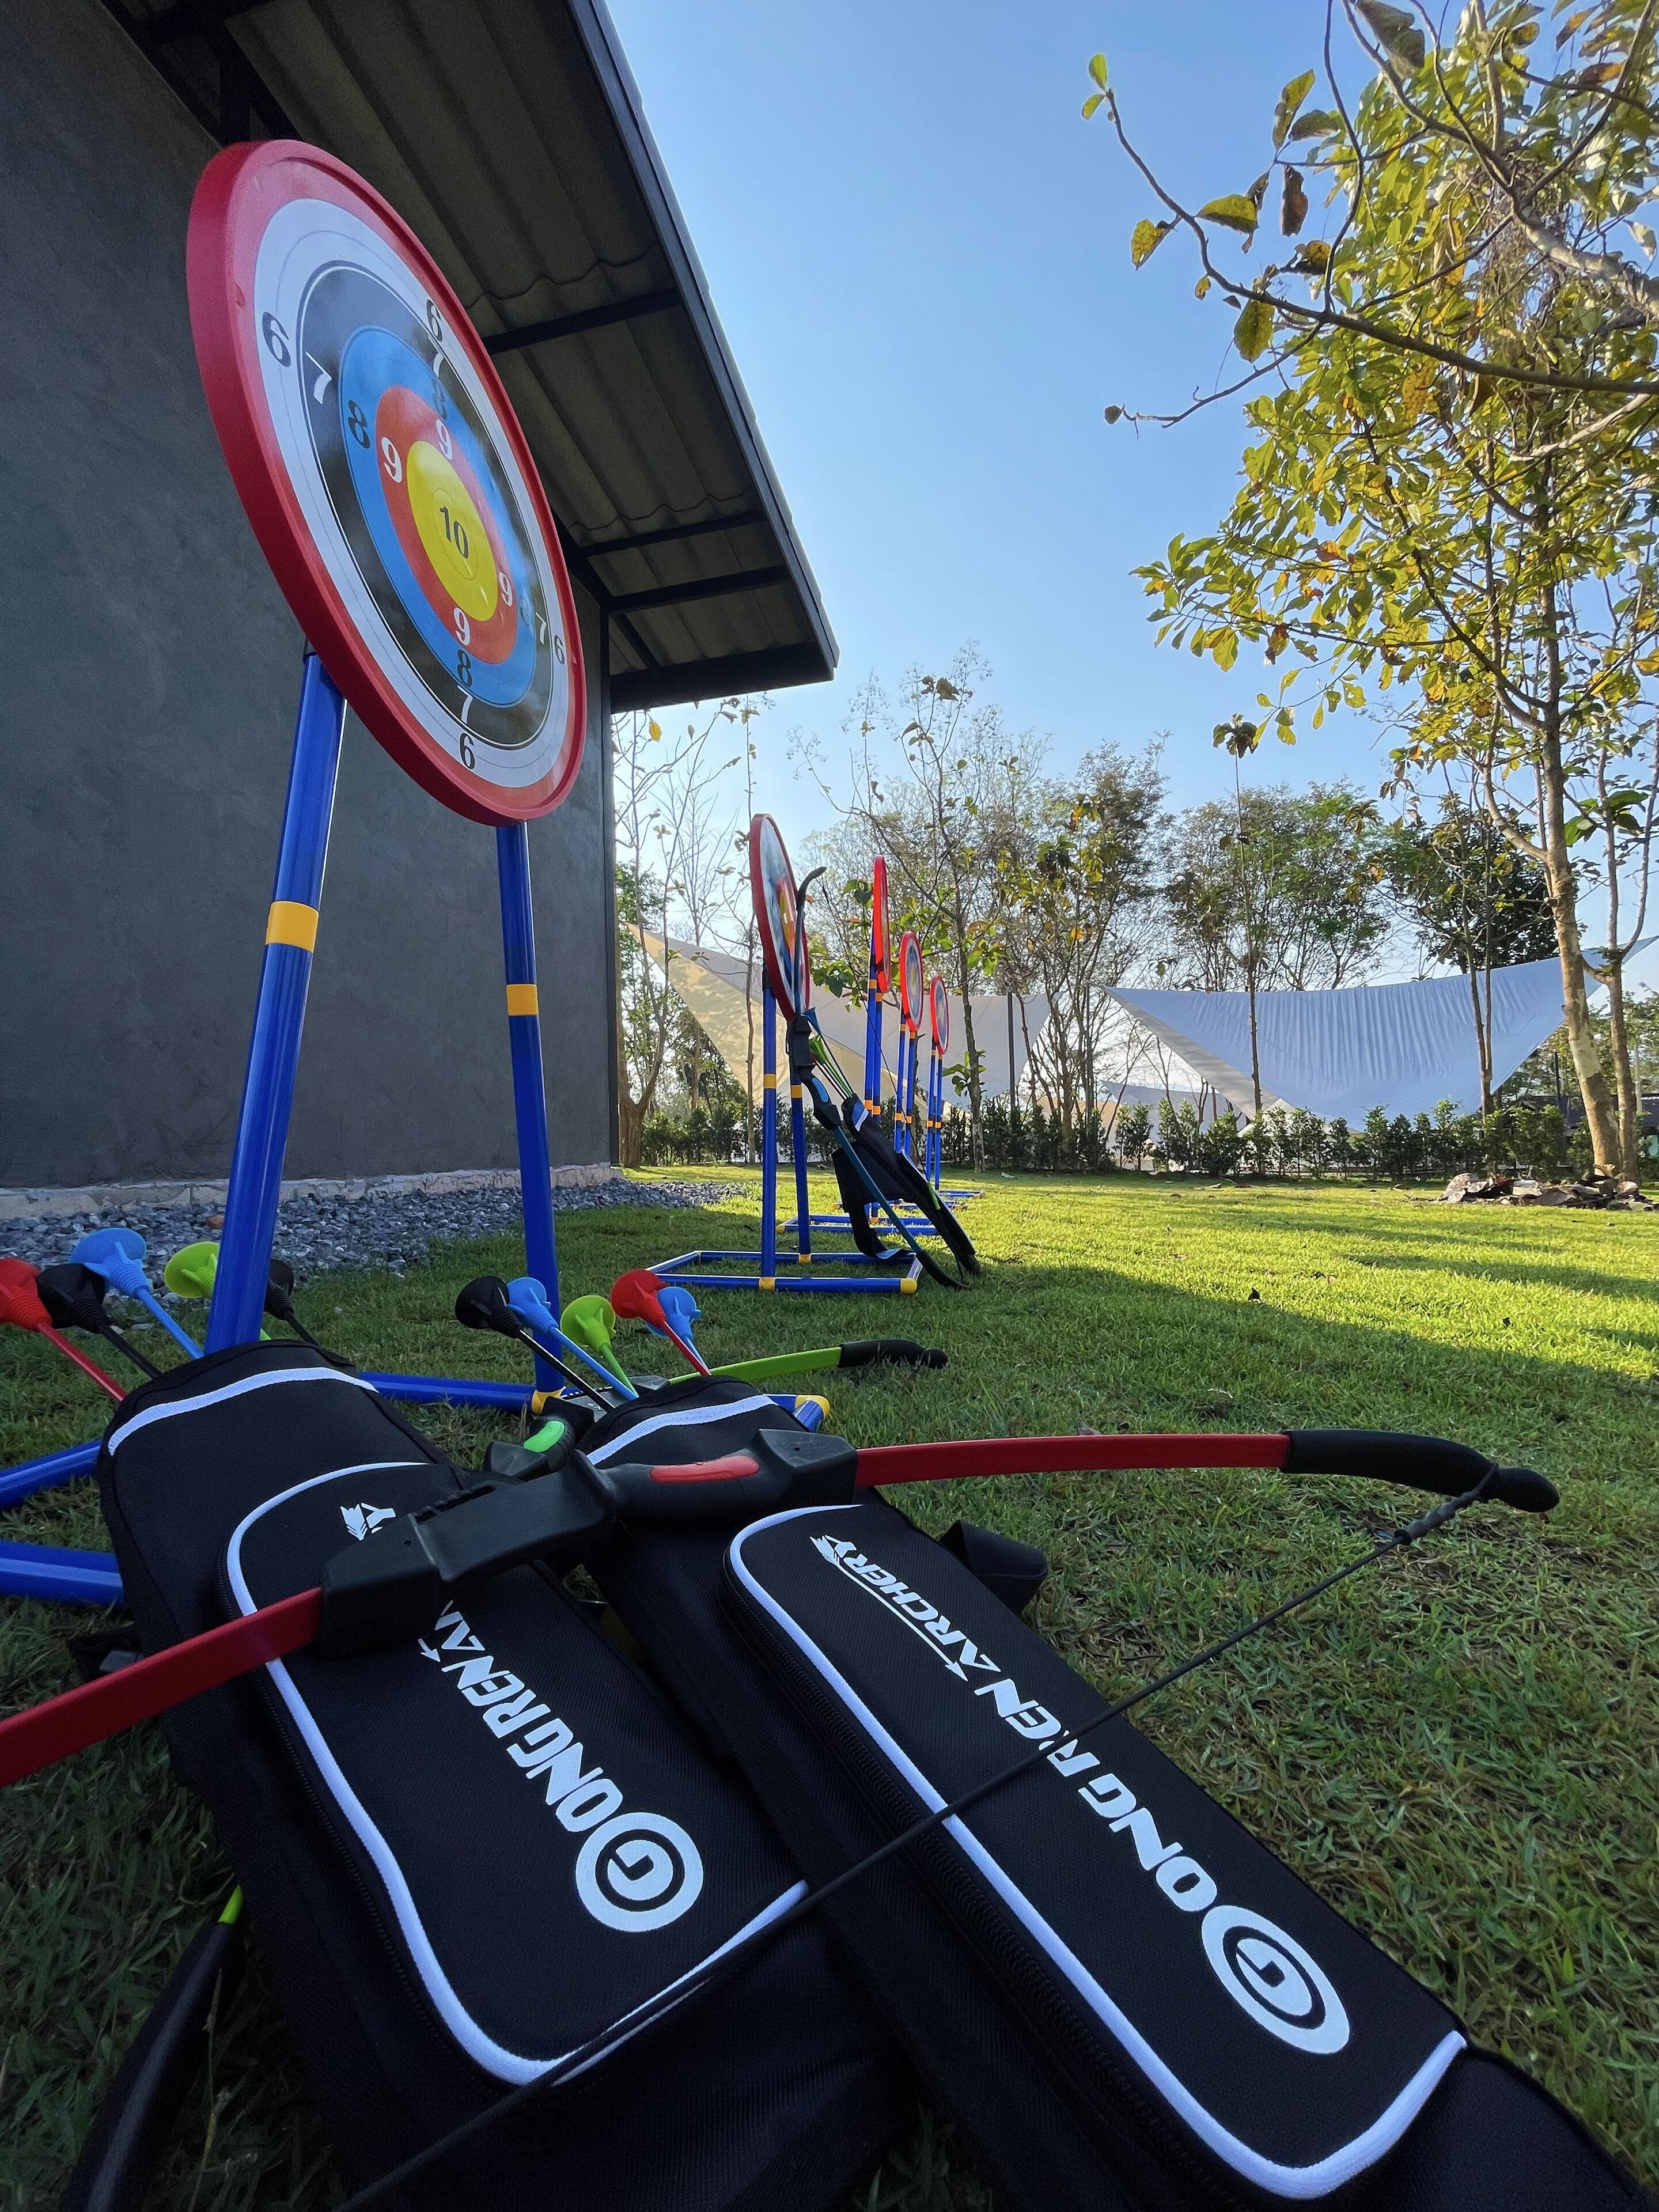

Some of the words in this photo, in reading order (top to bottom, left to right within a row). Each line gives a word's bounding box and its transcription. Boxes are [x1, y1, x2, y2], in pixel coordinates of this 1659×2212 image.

[427, 299, 442, 342] 6
[435, 419, 453, 460] 9
[262, 312, 291, 368] 6
[305, 350, 332, 405] 7
[347, 400, 370, 449] 8
[381, 437, 403, 483] 9
[440, 506, 469, 559] 10
[499, 571, 513, 608] 9
[535, 611, 547, 645] 7
[554, 635, 565, 665] 6
[453, 607, 471, 646] 9
[457, 649, 473, 688] 8
[457, 684, 474, 725] 7
[460, 732, 475, 770] 6
[825, 1535, 1001, 1672] ARCHERY
